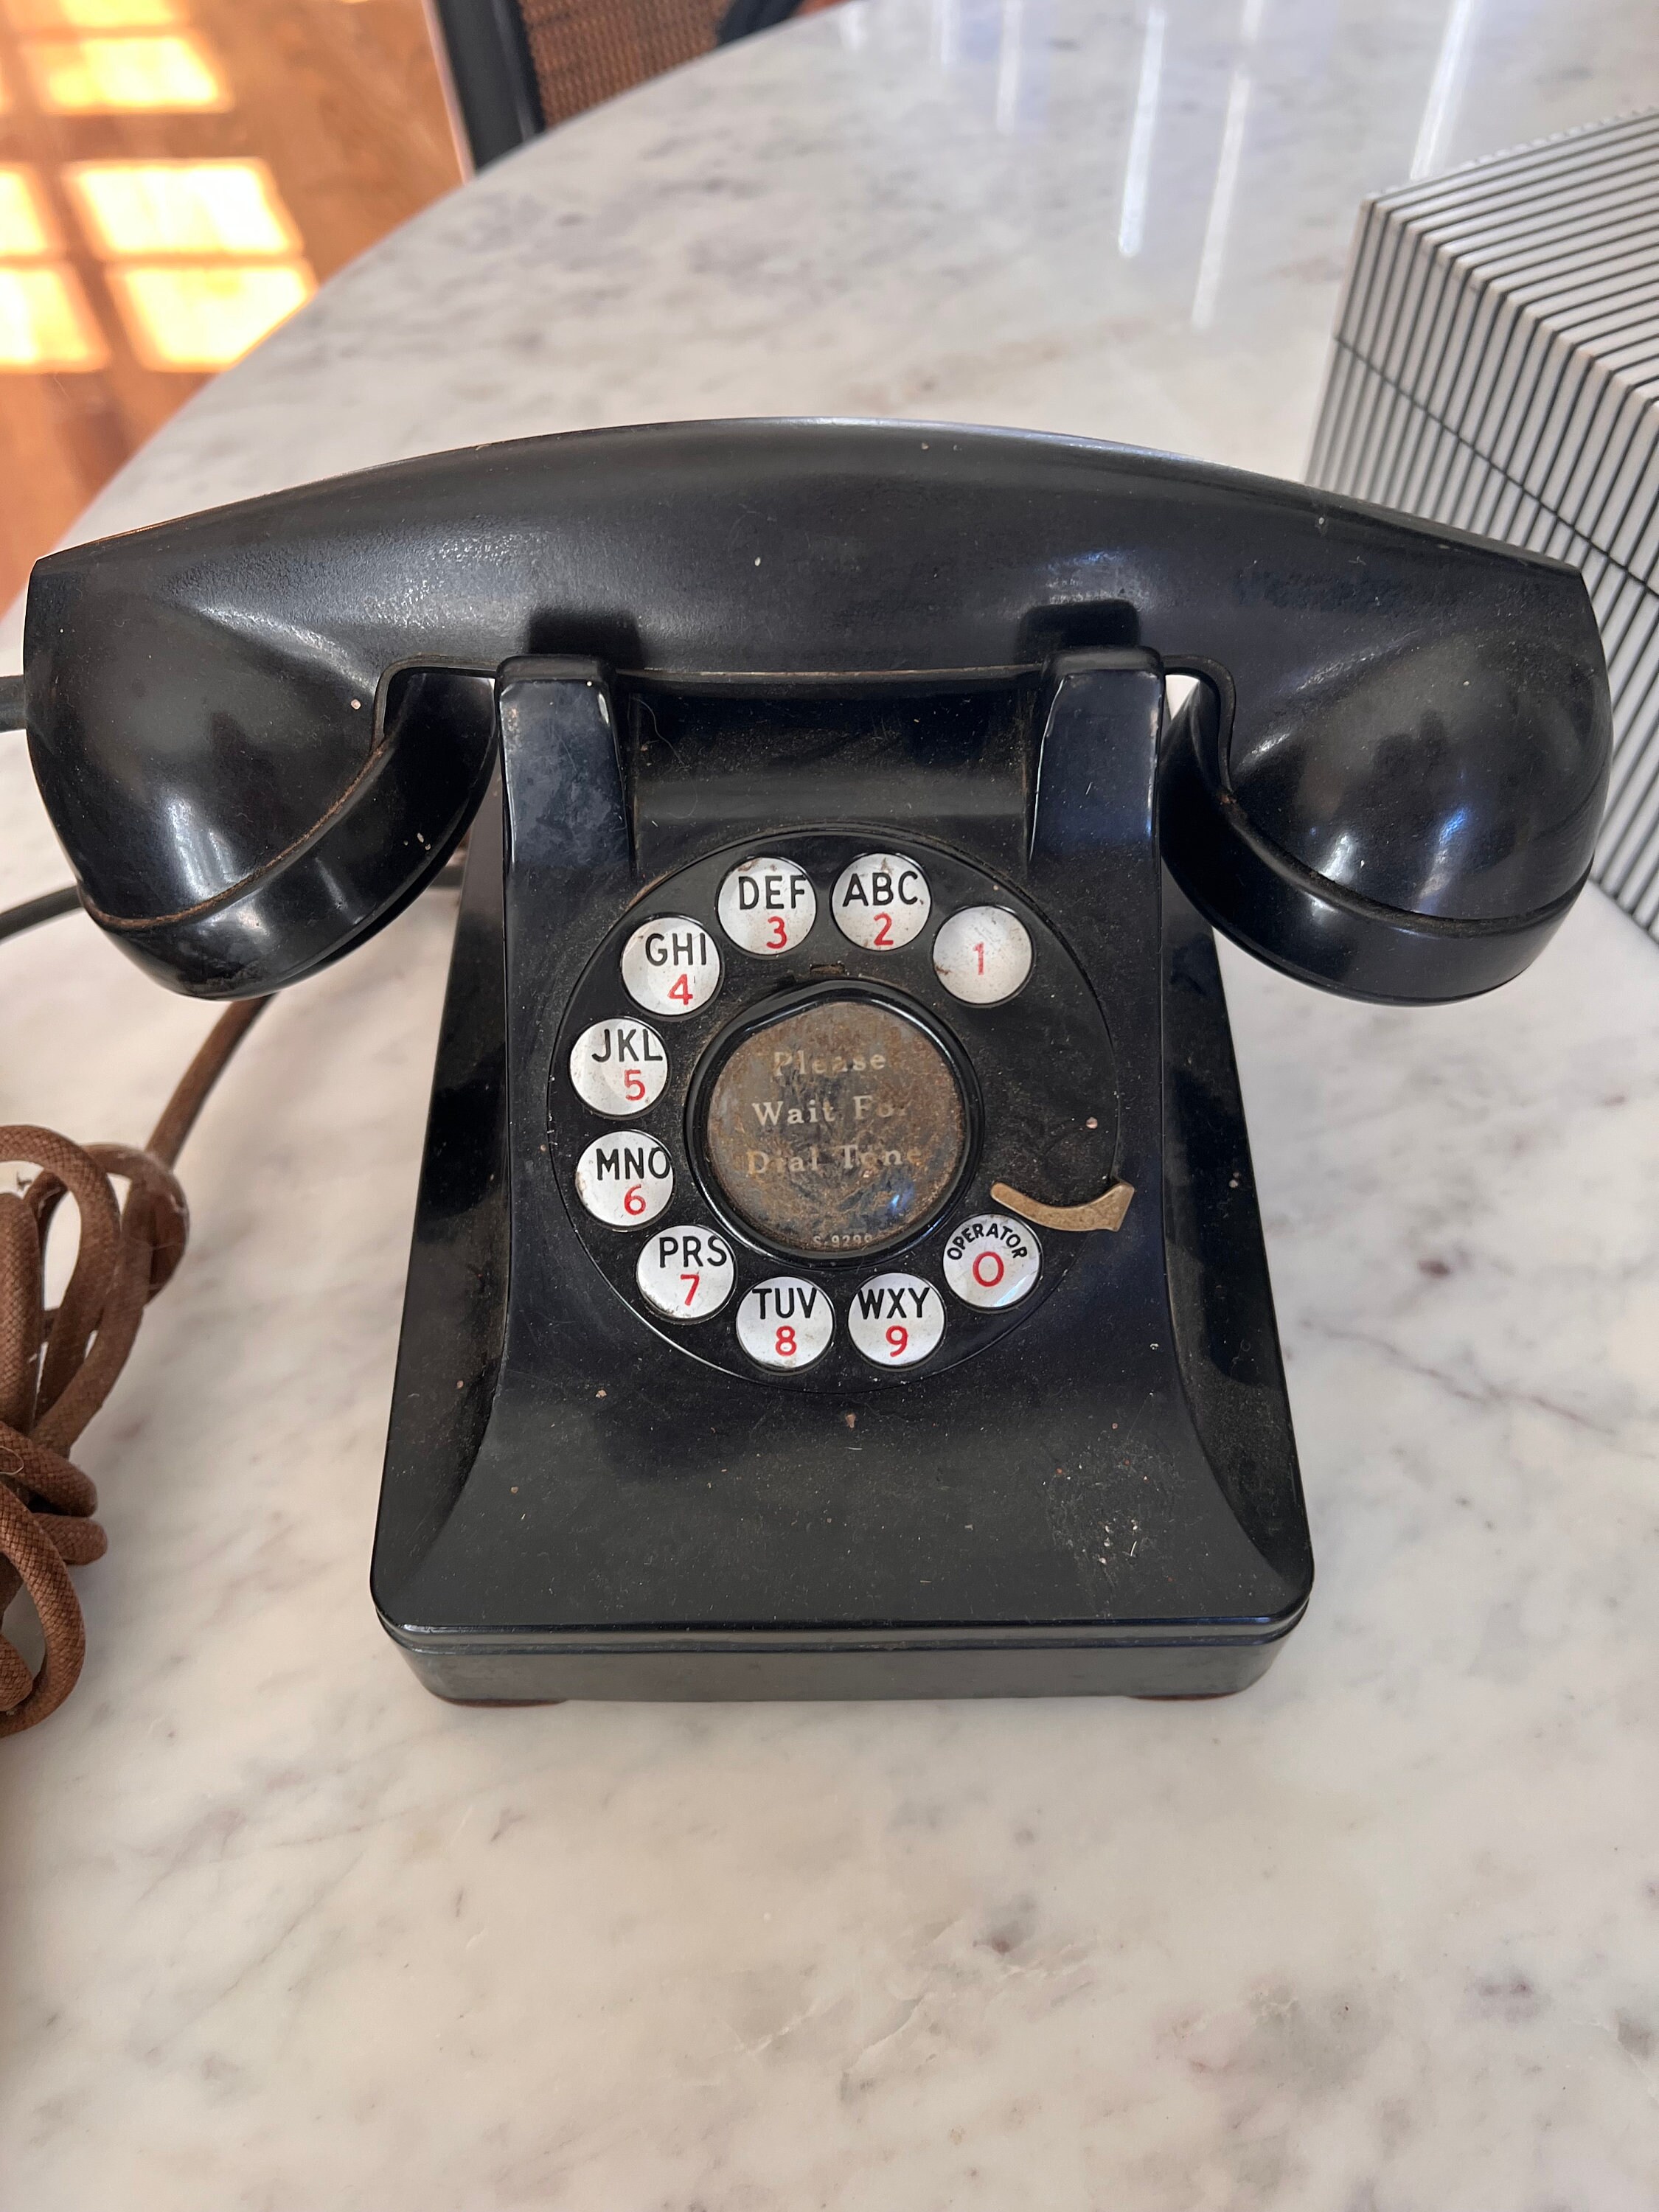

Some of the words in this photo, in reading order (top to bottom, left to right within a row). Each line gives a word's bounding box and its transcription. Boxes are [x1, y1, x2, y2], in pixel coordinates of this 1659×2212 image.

[738, 874, 808, 910] DEF
[842, 871, 919, 908] ABC
[766, 916, 787, 949] 3
[873, 912, 894, 946] 2
[645, 933, 706, 966] GHI
[973, 942, 984, 975] 1
[667, 973, 693, 1005] 4
[591, 1029, 663, 1062] JKL
[774, 1050, 886, 1077] Please
[625, 1069, 645, 1101] 5
[752, 1099, 836, 1127] Wait
[596, 1147, 670, 1180] MNO
[624, 1183, 646, 1215] 6
[659, 1236, 727, 1268] PRS
[947, 1222, 1028, 1261] OPERATOR
[680, 1274, 700, 1306] 7
[751, 1287, 817, 1320] TUV
[858, 1287, 930, 1320] WXY
[775, 1326, 797, 1357] 8
[886, 1326, 908, 1357] 9
